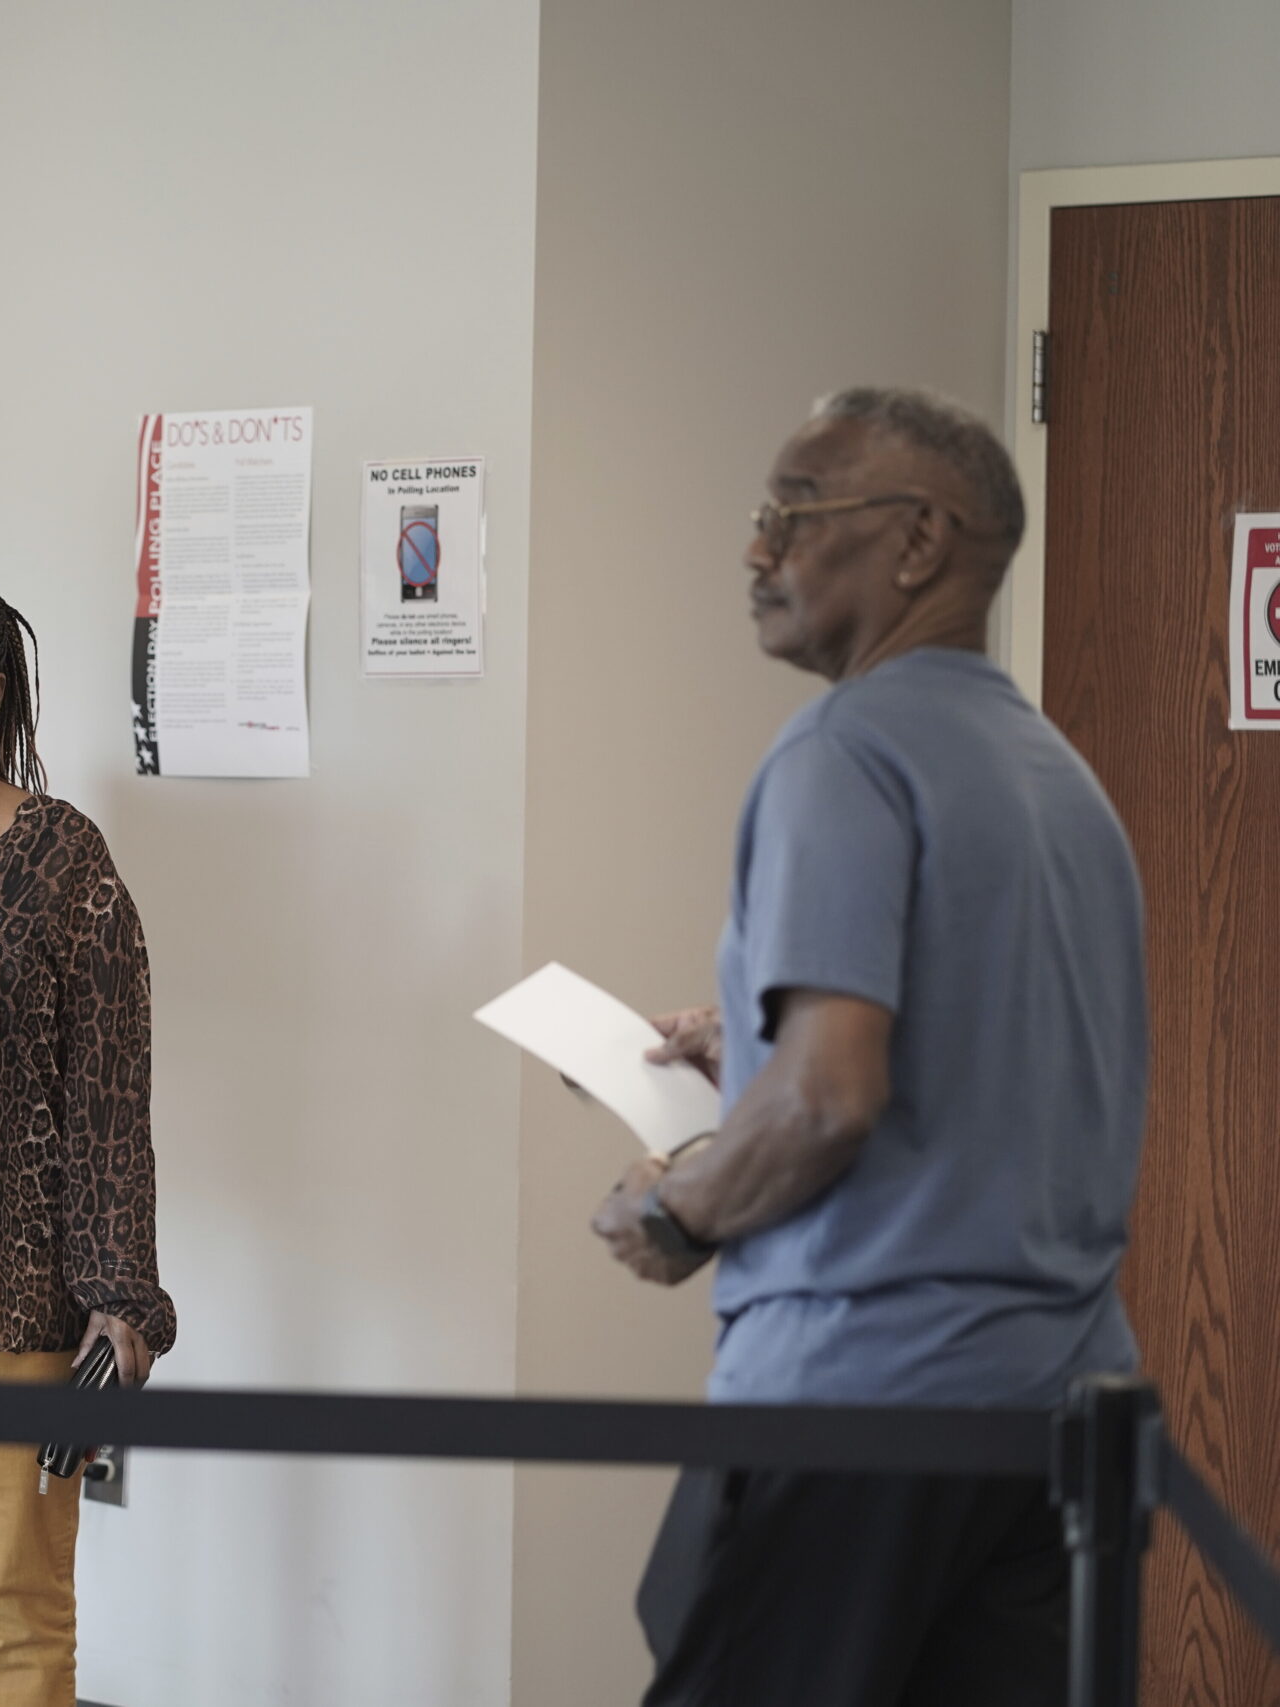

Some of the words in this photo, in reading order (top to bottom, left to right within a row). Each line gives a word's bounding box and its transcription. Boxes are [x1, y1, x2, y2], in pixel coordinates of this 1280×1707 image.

[212, 421, 224, 445] &
[149, 440, 162, 510] PLACE
[371, 470, 388, 481] NO
[392, 468, 422, 480] CELL
[426, 466, 477, 479] PHONES
[398, 486, 423, 495] Polling
[426, 486, 460, 494] Location
[1265, 542, 1280, 553] VOT
[148, 519, 162, 615] POLLING
[147, 619, 159, 655] DAY
[400, 637, 428, 645] silence
[431, 637, 439, 645] all
[146, 660, 158, 742] ELECTION
